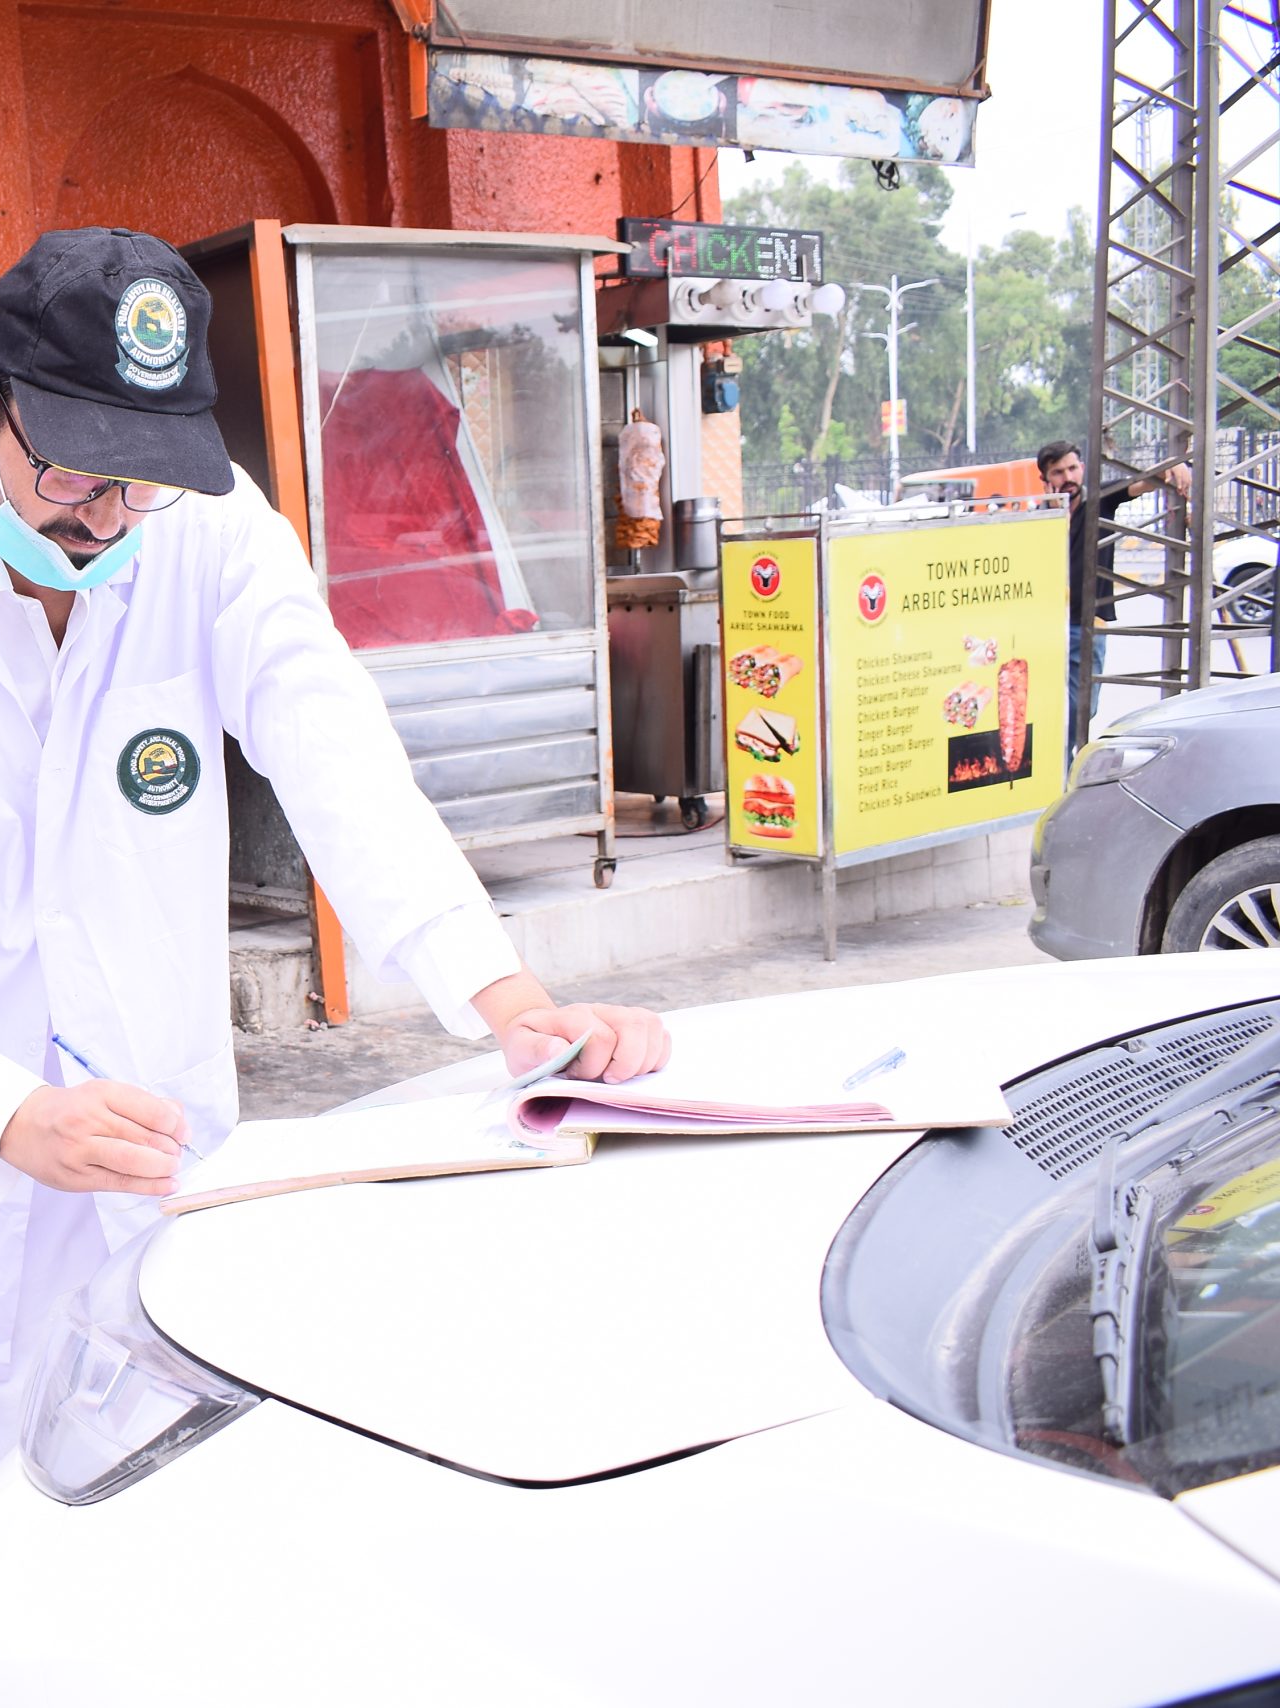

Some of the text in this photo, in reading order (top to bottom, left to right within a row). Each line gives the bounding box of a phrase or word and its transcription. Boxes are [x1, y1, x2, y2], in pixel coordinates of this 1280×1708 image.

[649, 230, 797, 275] CHICKEN
[130, 346, 176, 365] AUTHORITY
[927, 556, 1010, 580] TOWN FOOD
[902, 581, 1033, 612] ARBIC SHAWARMA
[743, 610, 790, 619] TOWN FOOD
[730, 622, 804, 632] ARBIC SHAWARMA
[857, 651, 933, 670] Chicken Shawarma
[857, 664, 962, 688] Chicken Cheese Shawarma
[857, 692, 898, 706] Shawarma
[857, 706, 920, 724] Chicken Burger
[858, 724, 913, 742] Zinger Burger
[858, 738, 934, 758] Anda Shami Burger
[858, 760, 912, 777] Shami Burger
[146, 778, 179, 793] AUTHORITY
[858, 779, 898, 795] Fried Rice
[859, 799, 890, 813] Chicken
[905, 787, 941, 802] Sandwich
